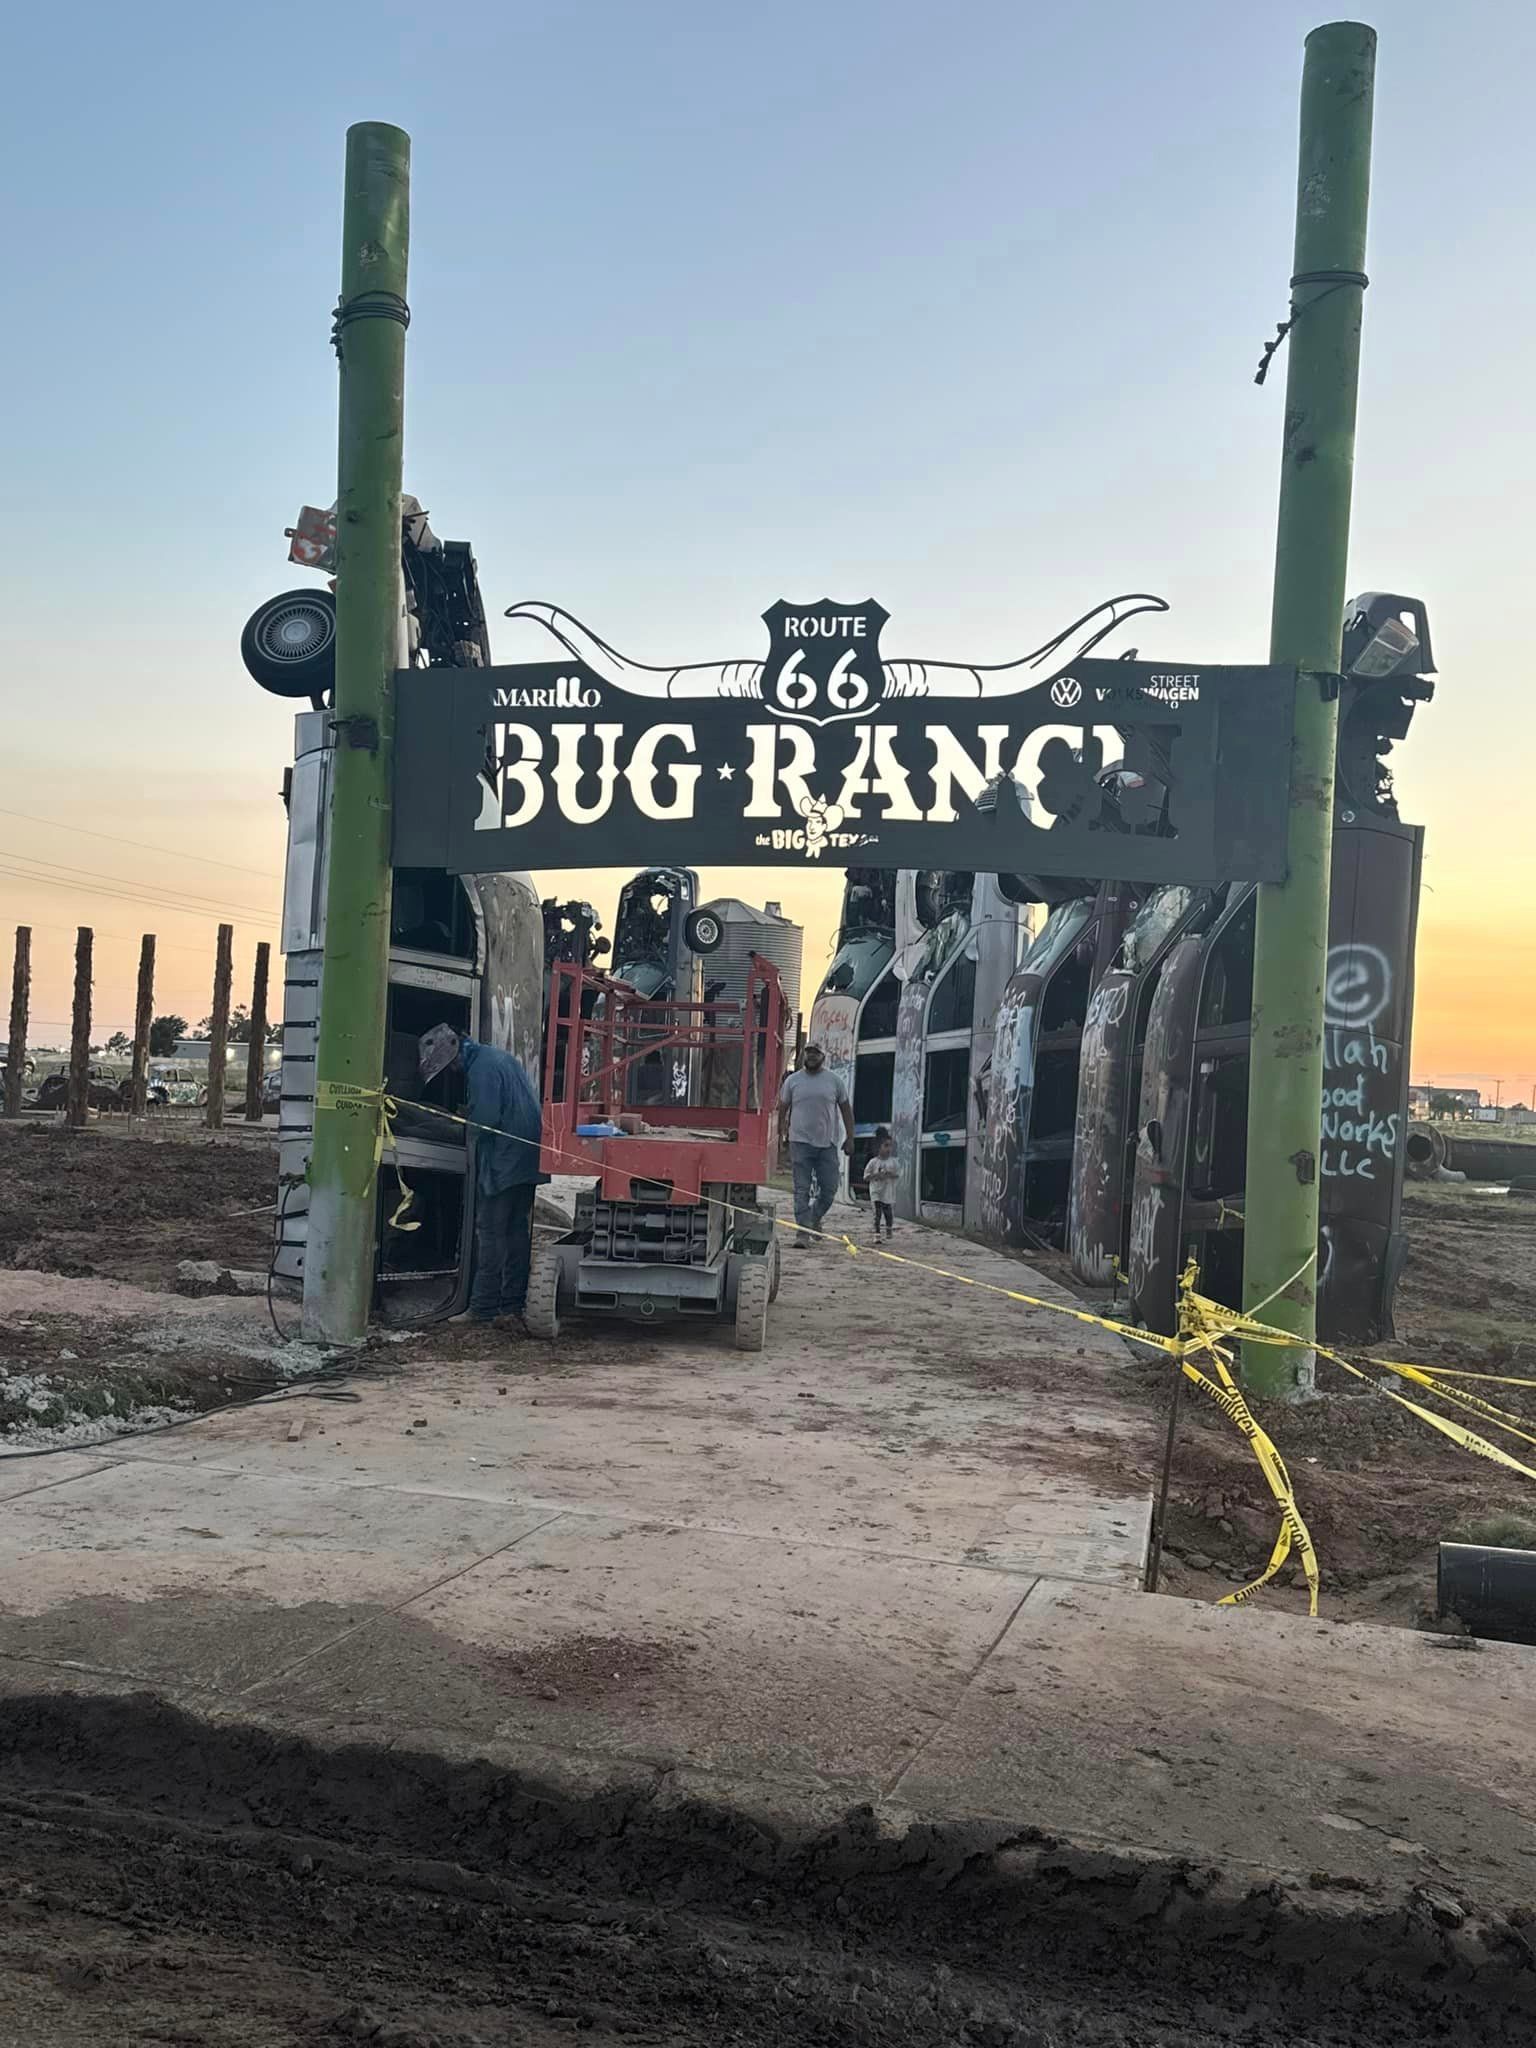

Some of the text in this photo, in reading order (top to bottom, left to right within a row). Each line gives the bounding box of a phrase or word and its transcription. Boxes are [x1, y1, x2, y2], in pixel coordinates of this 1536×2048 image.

[785, 616, 867, 638] ROUTE
[776, 648, 869, 709] 66
[1150, 674, 1200, 688] STREET
[474, 723, 702, 829] BUG
[755, 833, 771, 847] the
[771, 829, 805, 850] BIG
[1275, 1498, 1311, 1553] CAUTION
